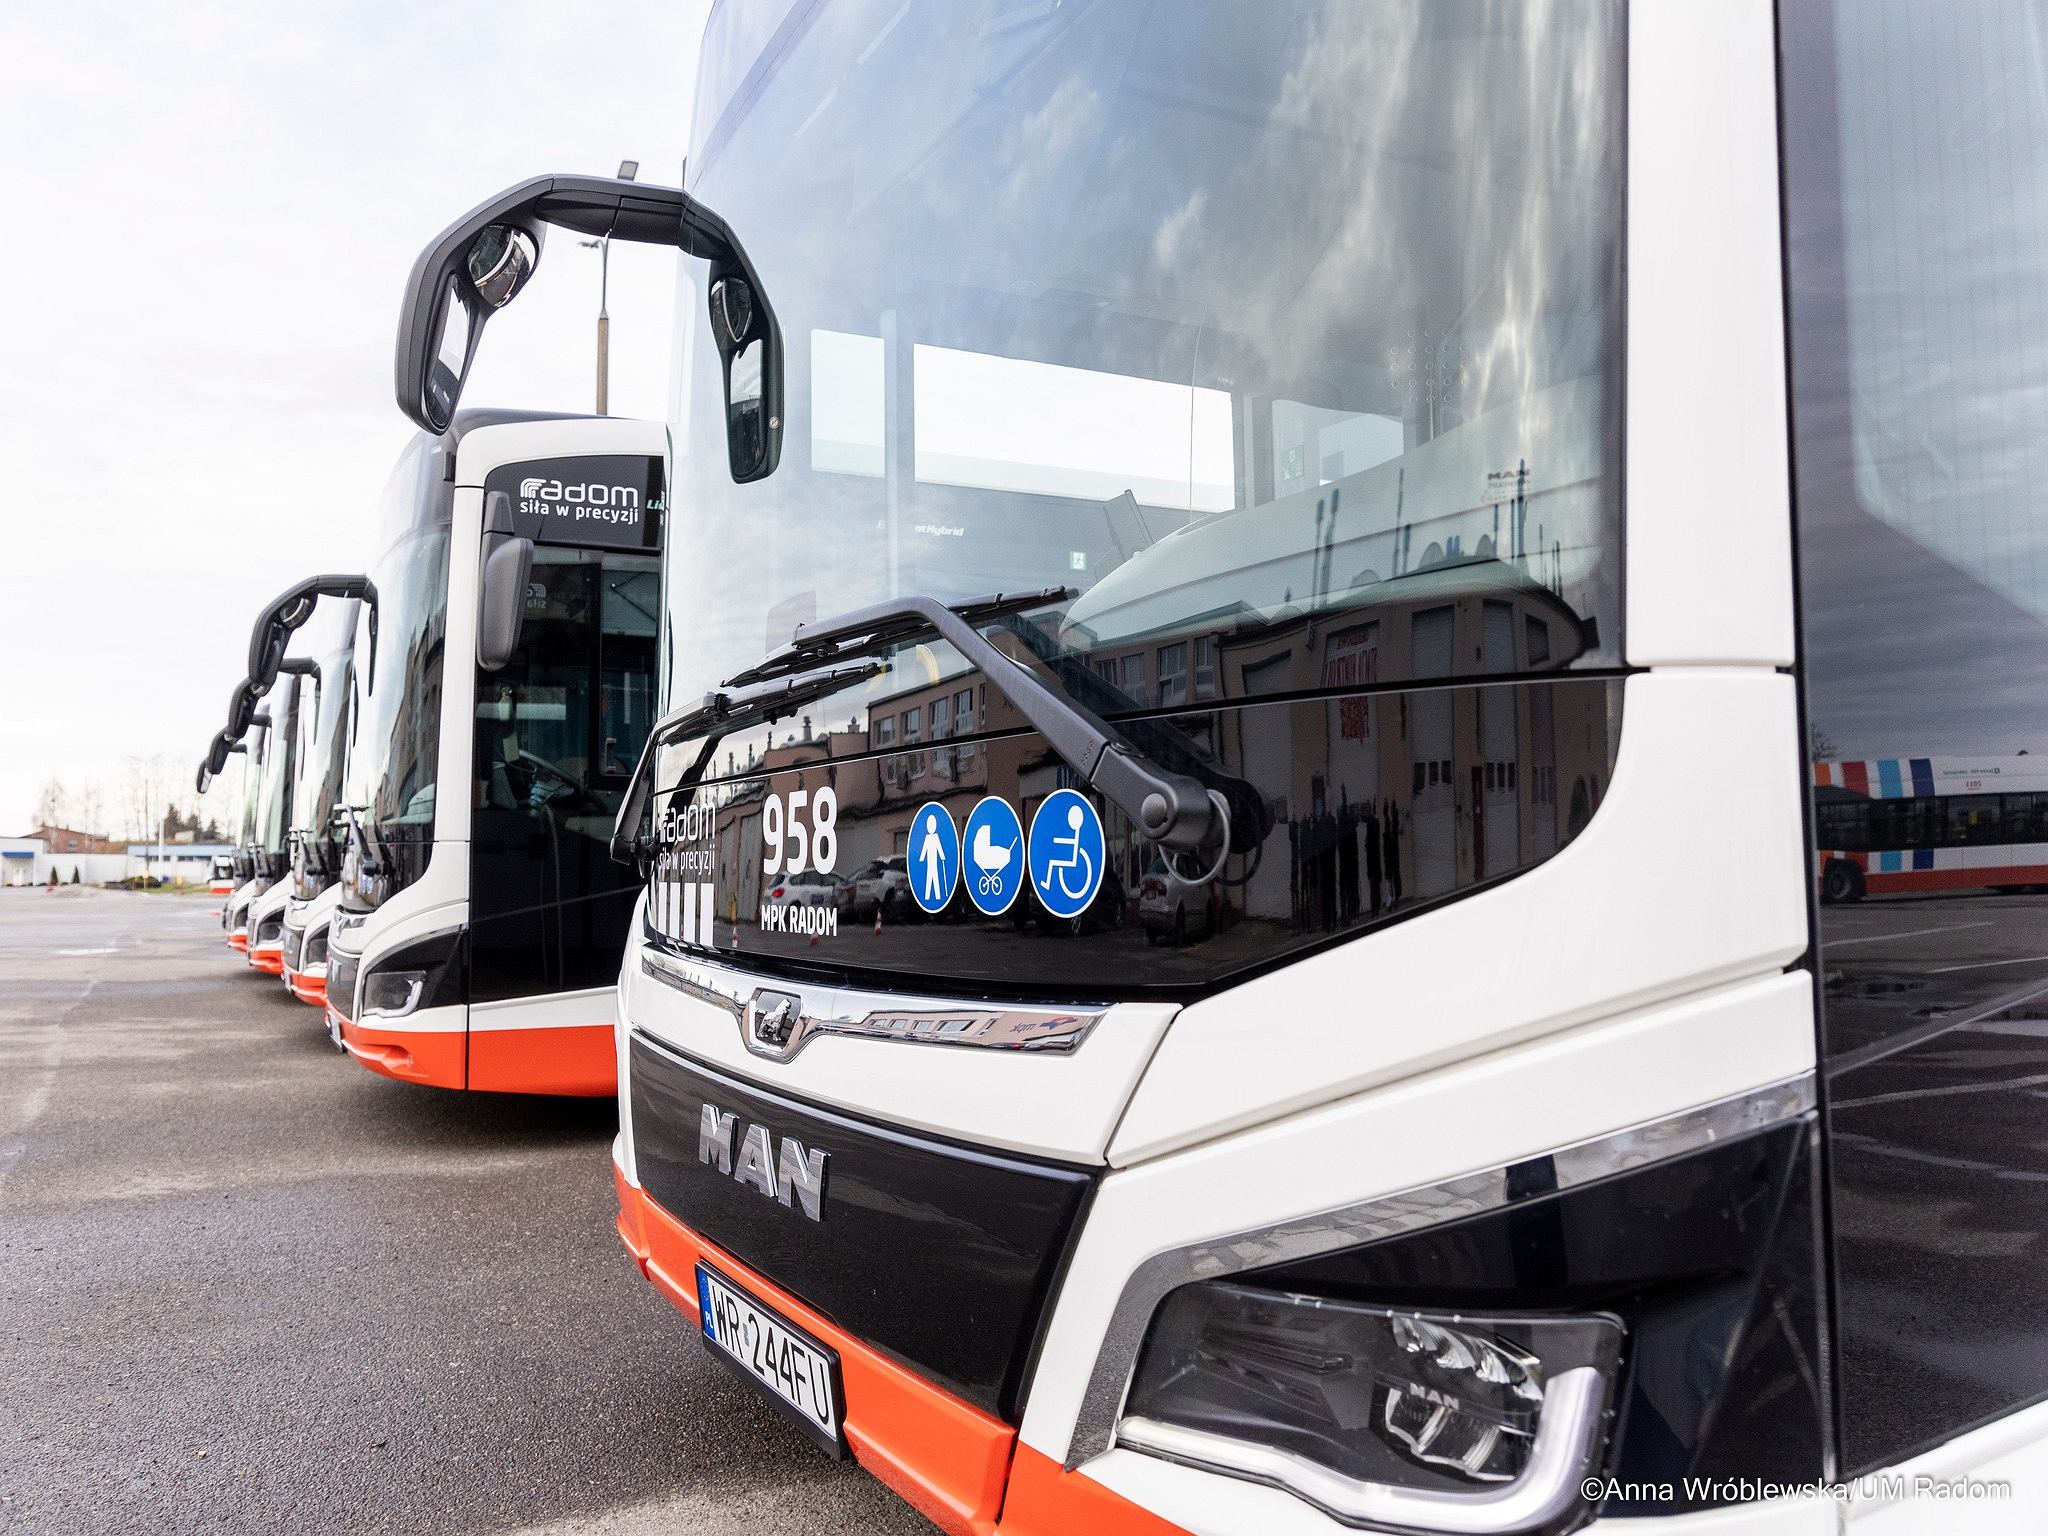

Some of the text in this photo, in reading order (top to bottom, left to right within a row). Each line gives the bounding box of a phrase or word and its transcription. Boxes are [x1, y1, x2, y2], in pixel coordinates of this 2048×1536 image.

[520, 501, 639, 525] siła w precyzji
[762, 786, 838, 875] 958
[671, 851, 679, 870] w
[680, 843, 716, 876] precyzji
[761, 904, 838, 937] MPK RADOM
[699, 1103, 832, 1222] MAN
[704, 1310, 714, 1329] PL
[712, 1284, 830, 1426] WR 244FU
[1409, 1382, 1460, 1411] MAN
